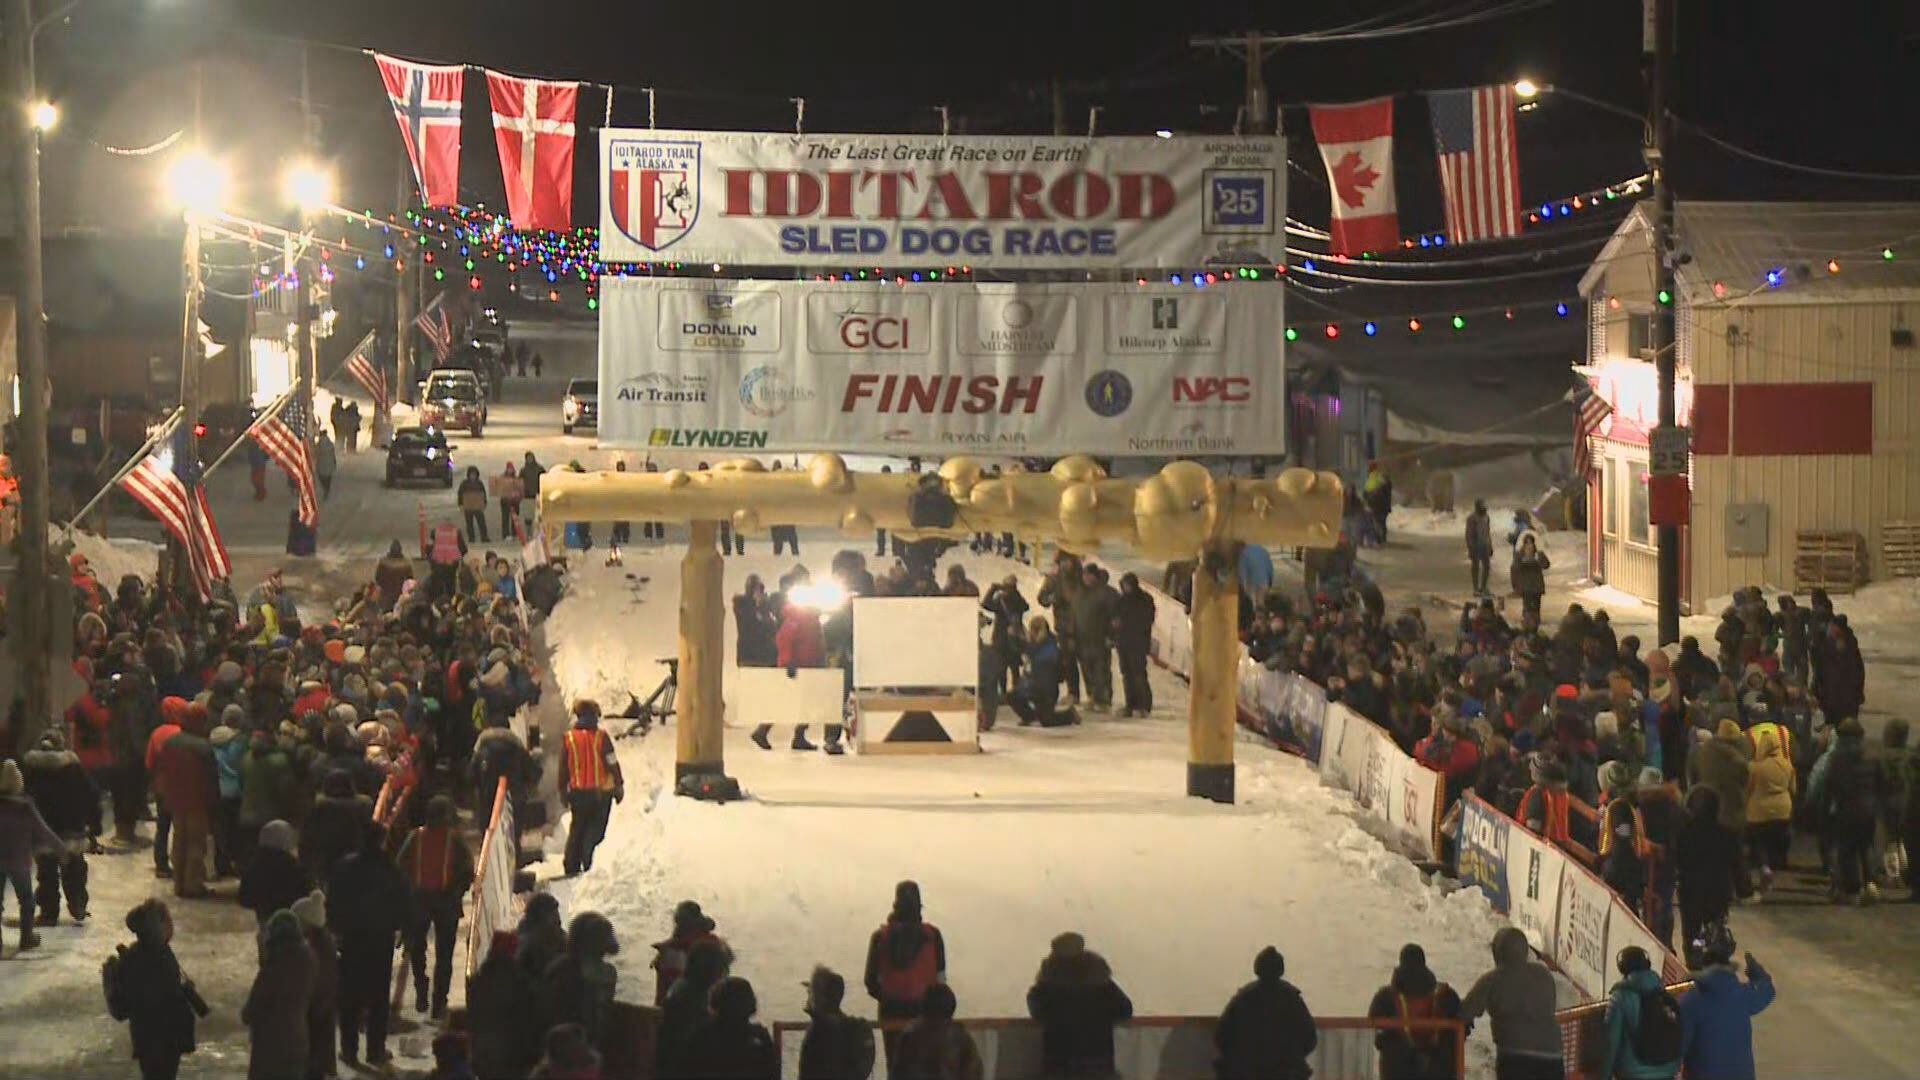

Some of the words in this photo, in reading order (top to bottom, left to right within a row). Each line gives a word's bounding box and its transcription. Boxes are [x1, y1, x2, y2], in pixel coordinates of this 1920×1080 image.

[616, 146, 662, 158] IDITAROD
[667, 148, 695, 159] TRAIL
[807, 144, 840, 160] The
[846, 145, 887, 161] Last
[893, 145, 944, 161] Great
[950, 146, 997, 162] Race
[1002, 149, 1027, 162] on
[1032, 146, 1082, 162] Earth
[636, 158, 675, 170] ALASKA
[718, 167, 1176, 221] IDITAROD
[780, 224, 887, 254] SLED
[901, 226, 993, 256] DOG
[1004, 228, 1117, 257] RACE
[682, 323, 757, 337] DONLIN
[840, 317, 909, 350] GCI
[693, 336, 746, 349] GOLD
[616, 387, 645, 401] Air
[646, 388, 709, 403] Transit
[841, 374, 1045, 415] FINISH
[1172, 376, 1251, 402] NAC
[670, 430, 768, 449] LYNDEN
